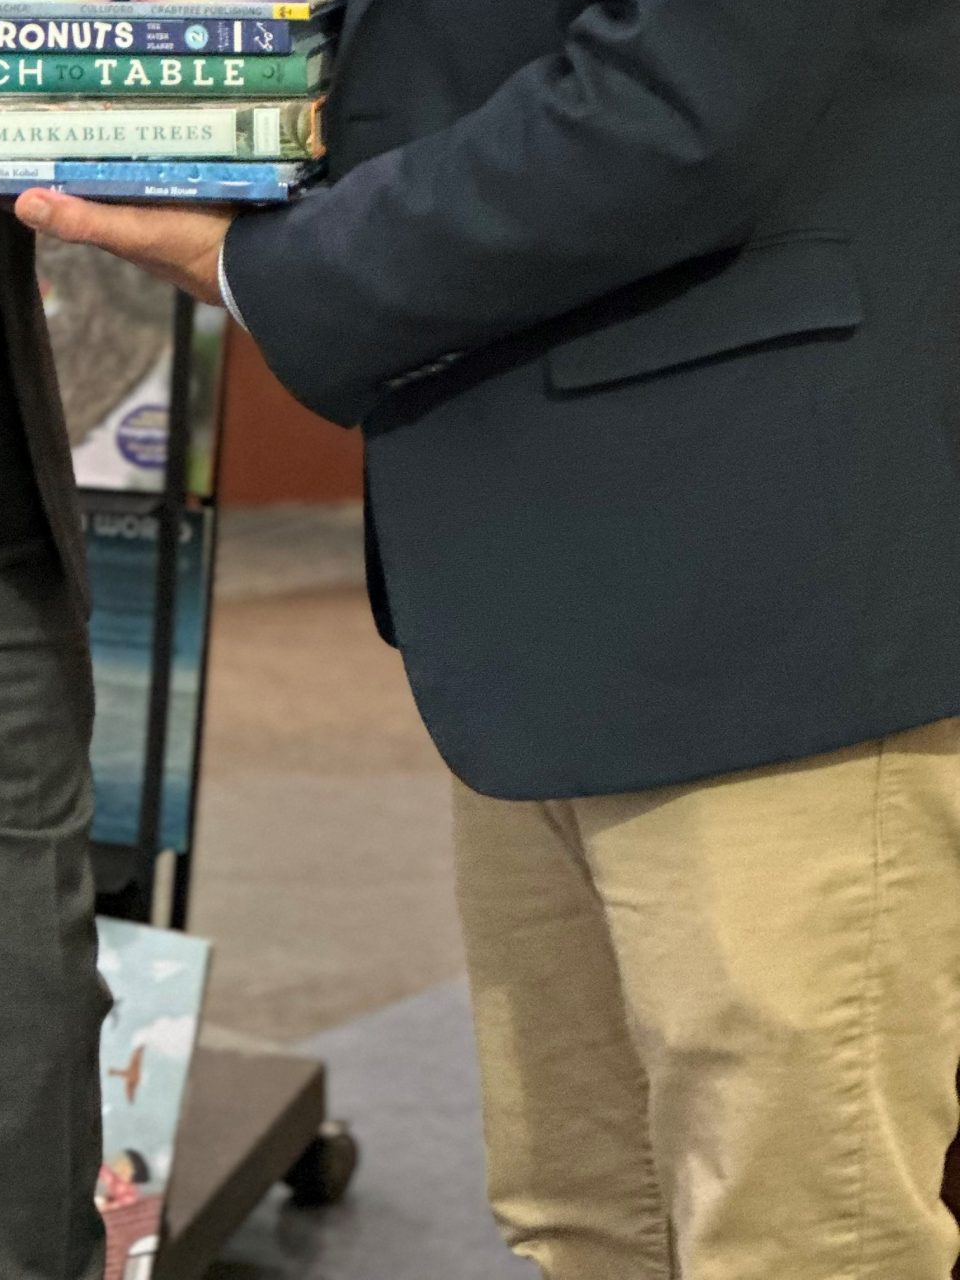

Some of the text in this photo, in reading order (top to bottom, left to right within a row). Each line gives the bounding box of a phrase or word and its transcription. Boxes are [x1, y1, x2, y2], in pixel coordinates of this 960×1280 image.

[56, 64, 85, 80] TO
[94, 58, 245, 86] TABLE
[136, 125, 213, 141] TREES
